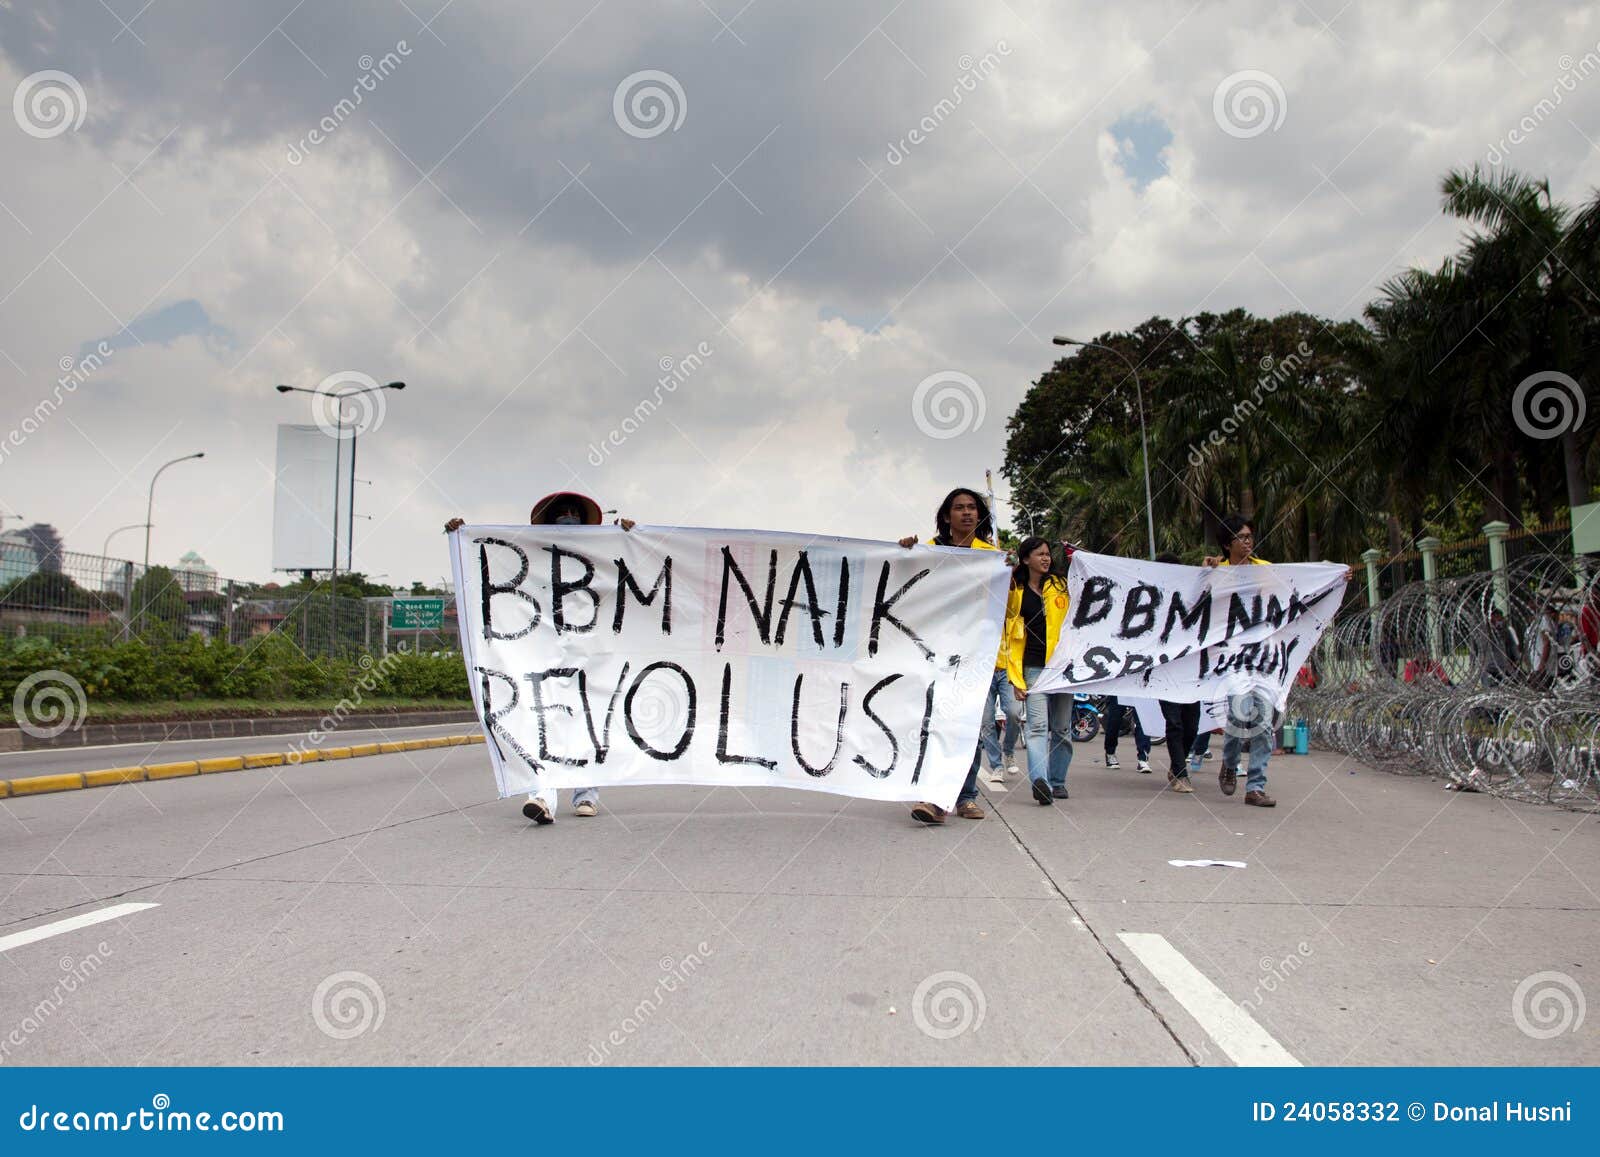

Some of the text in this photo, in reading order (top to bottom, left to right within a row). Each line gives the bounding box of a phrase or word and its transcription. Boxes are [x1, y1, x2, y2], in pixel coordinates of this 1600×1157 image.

[474, 537, 672, 642] BBM
[1072, 574, 1212, 646] BBM
[474, 661, 936, 786] REVOLUSI
